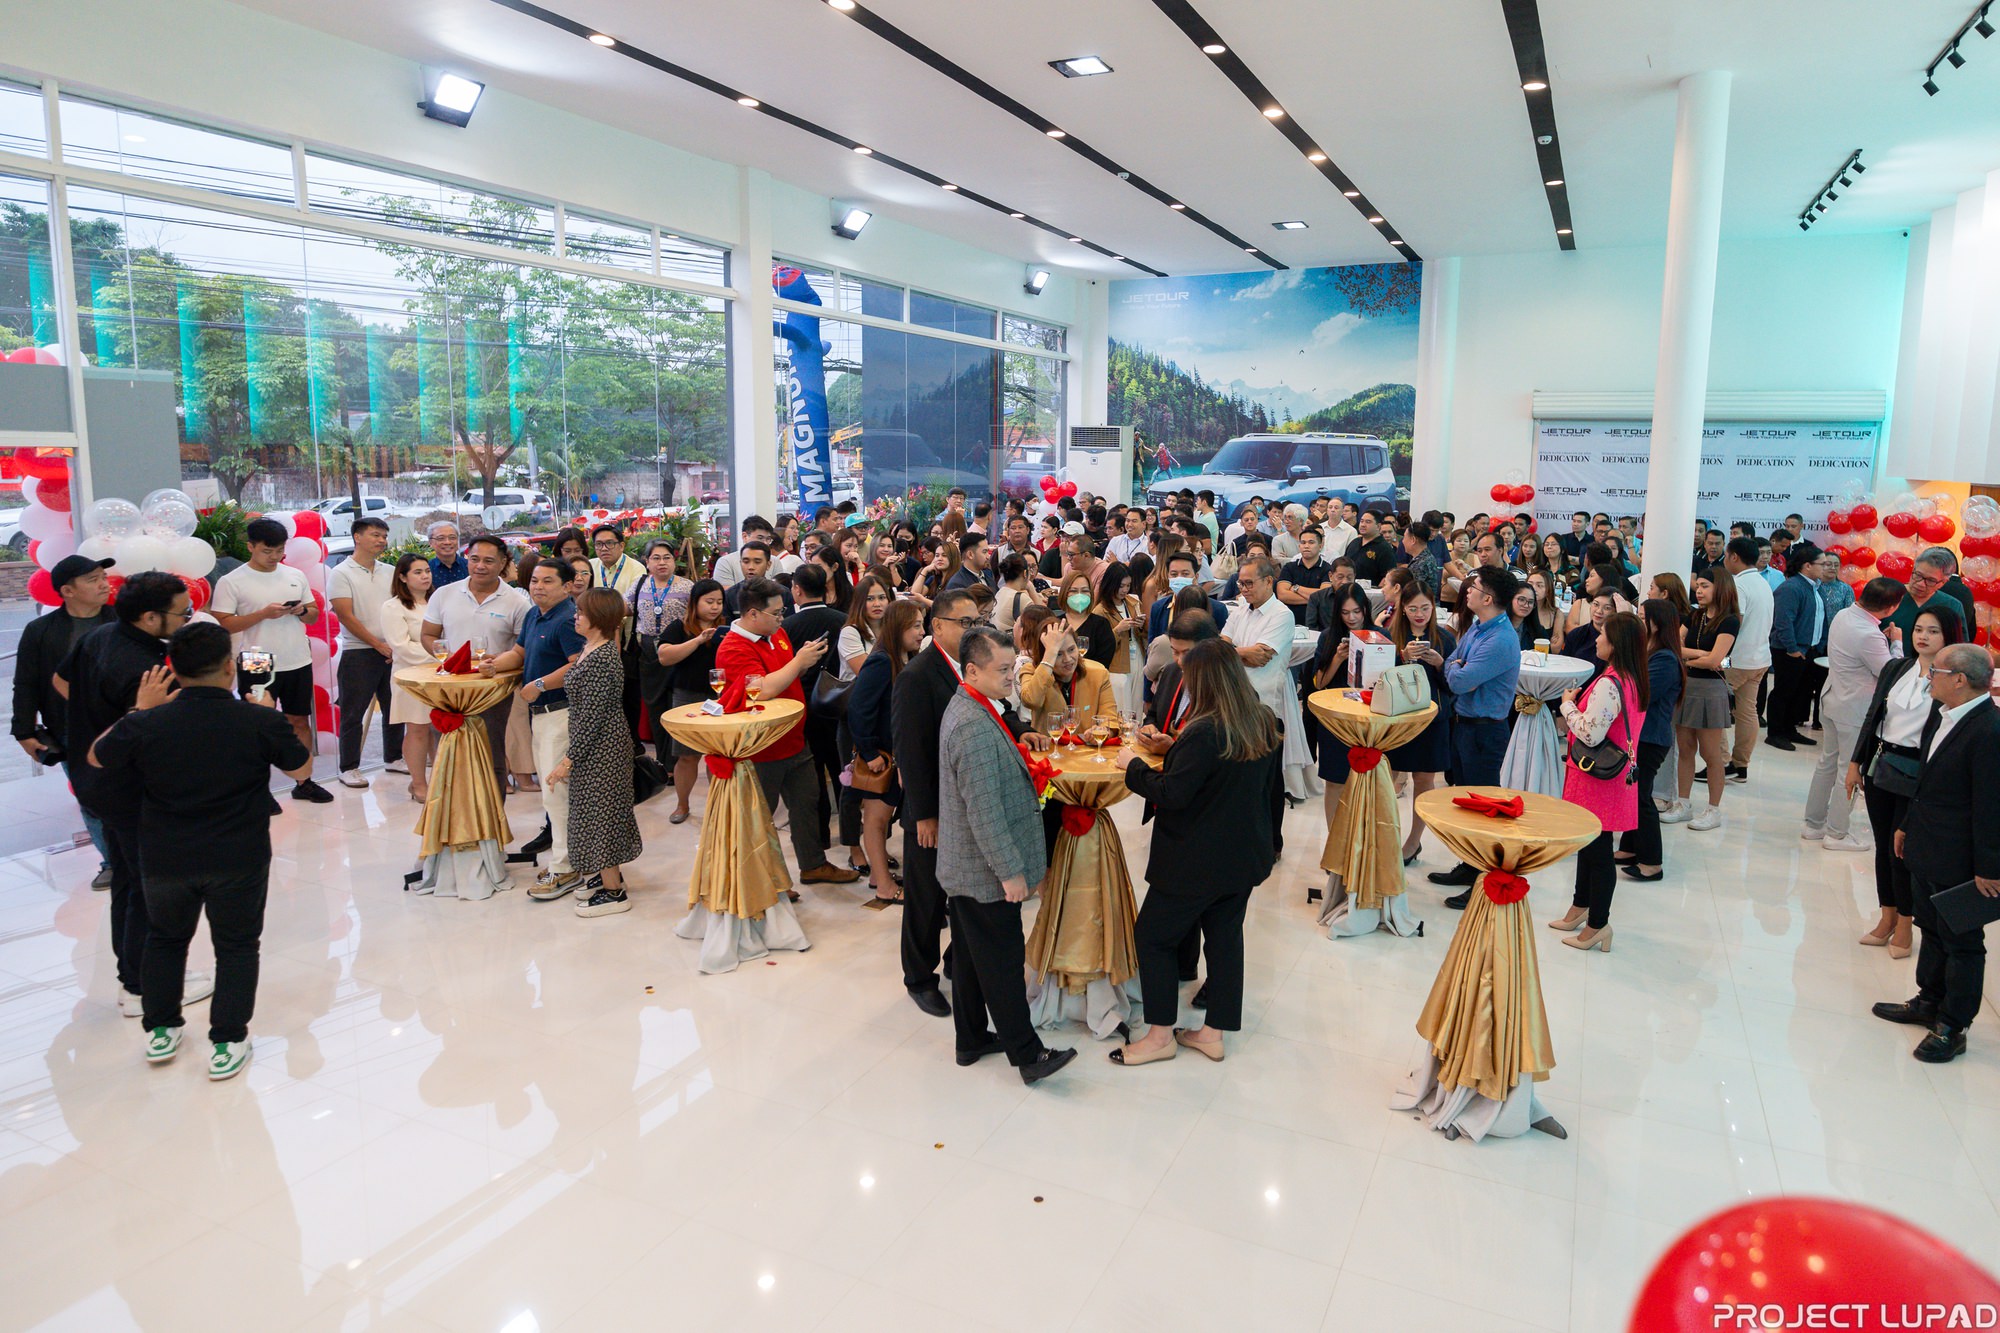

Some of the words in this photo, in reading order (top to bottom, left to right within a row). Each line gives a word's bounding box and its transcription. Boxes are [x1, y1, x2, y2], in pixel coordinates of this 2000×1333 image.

[1122, 291, 1189, 304] JETOUR
[1736, 458, 1794, 466] DEDICATION
[1809, 460, 1869, 468] DEDICATION
